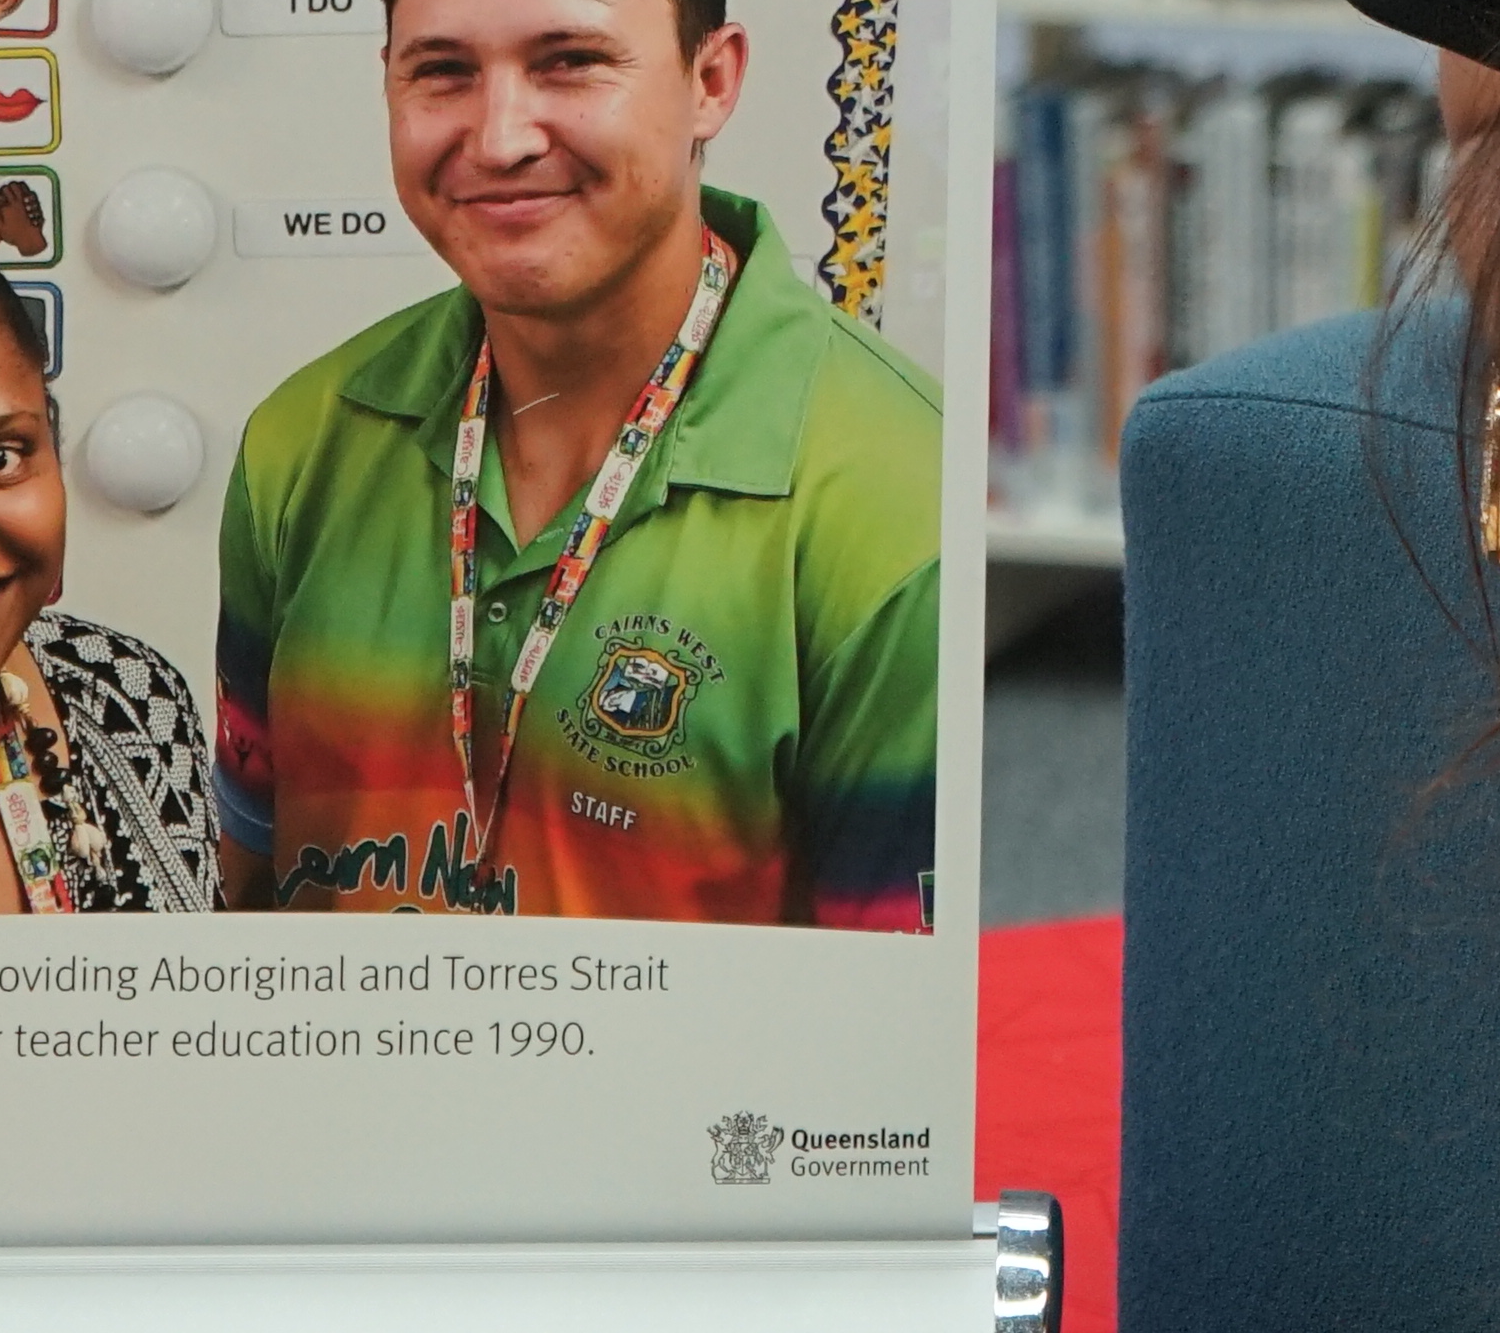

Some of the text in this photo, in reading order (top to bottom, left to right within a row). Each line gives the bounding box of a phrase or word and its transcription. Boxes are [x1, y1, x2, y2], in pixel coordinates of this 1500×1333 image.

[283, 210, 387, 237] WE DO
[594, 614, 727, 684] CAIRNS WEST
[555, 707, 600, 764] STATE
[603, 753, 697, 779] SCHOOL
[571, 790, 638, 831] STAFF
[149, 955, 346, 1001] Aboriginal
[359, 954, 431, 993] and
[442, 955, 559, 993] Torres
[569, 955, 670, 993] Strait
[14, 1020, 160, 1058] teacher
[171, 1020, 362, 1058] education
[376, 1020, 475, 1057] since
[488, 1021, 595, 1058] 1990.
[791, 1127, 931, 1153] Queensland
[791, 1156, 931, 1178] Government
